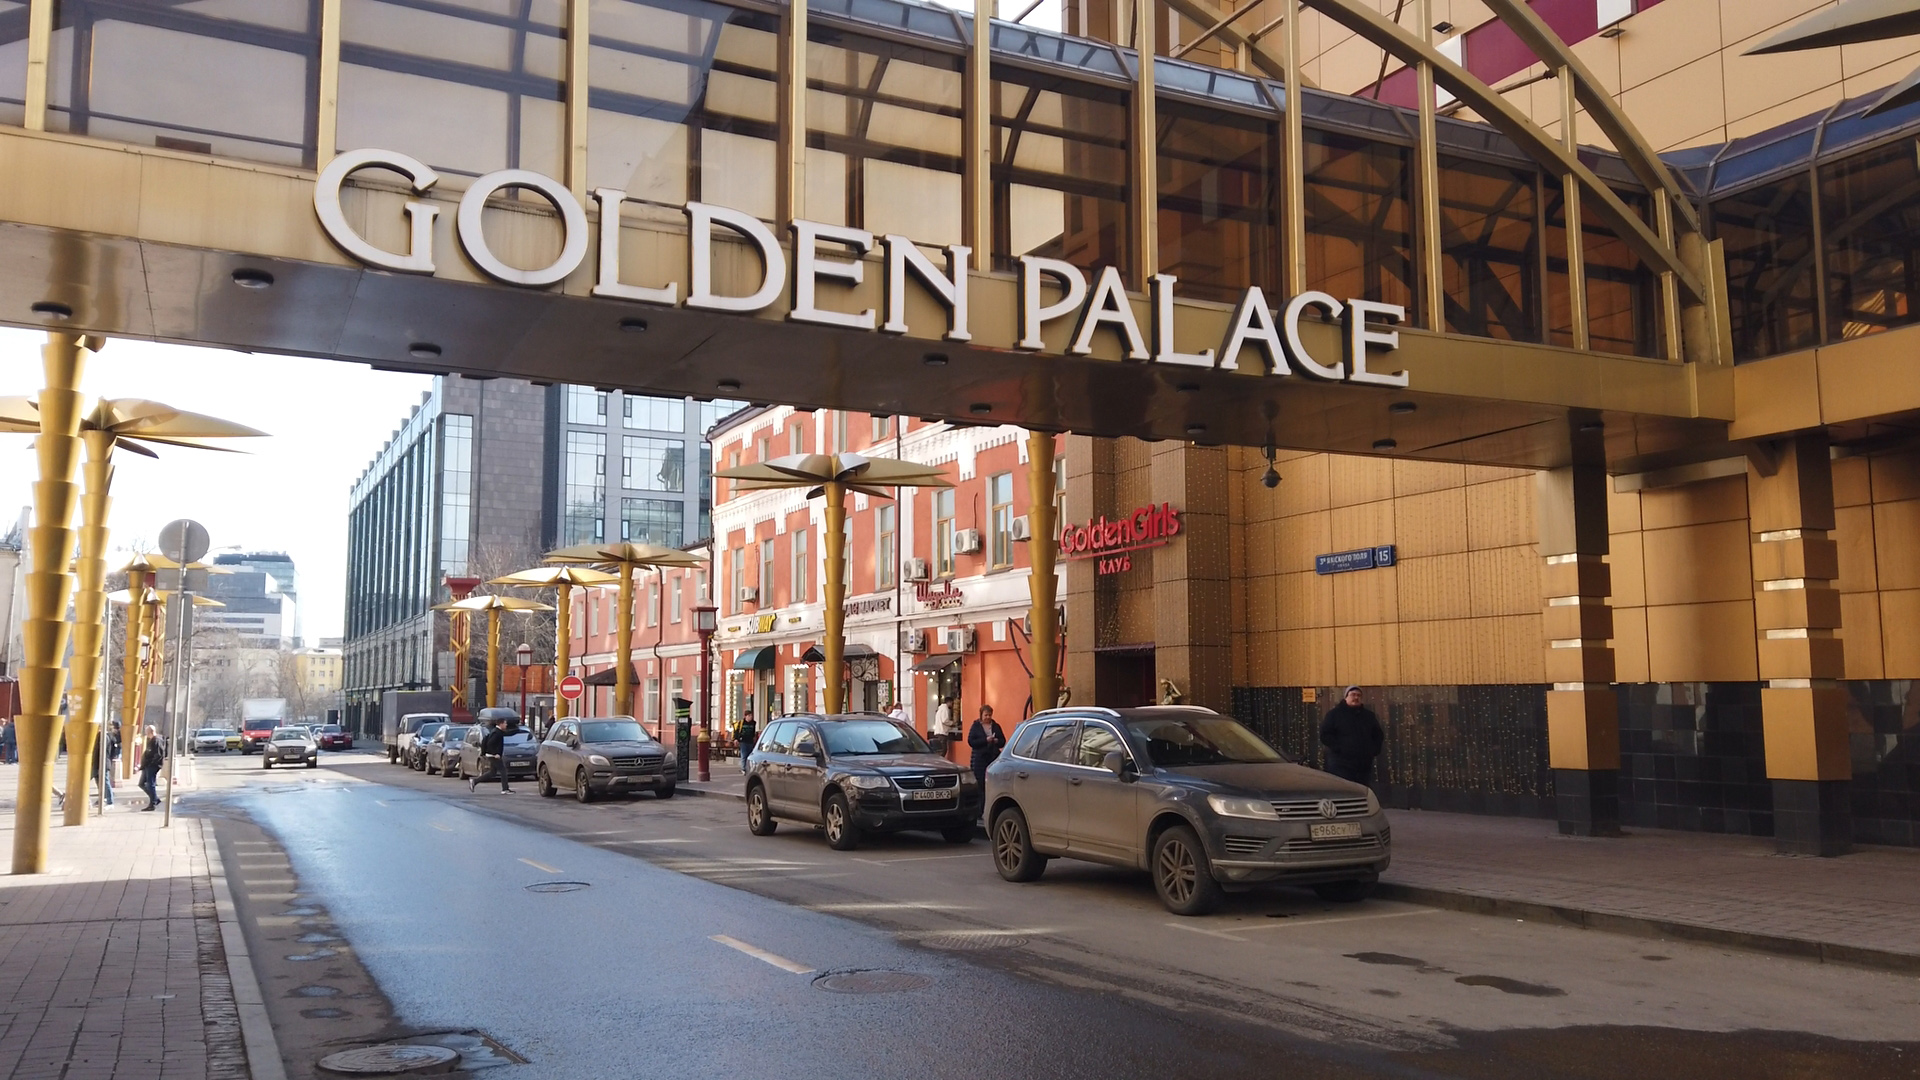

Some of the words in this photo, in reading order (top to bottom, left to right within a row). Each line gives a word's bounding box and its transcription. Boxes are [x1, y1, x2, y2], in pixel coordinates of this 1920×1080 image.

[314, 148, 972, 341] GOLDEN
[1017, 254, 1410, 388] PALACE
[1379, 550, 1388, 561] 15
[1099, 557, 1132, 575] КЛУБ
[747, 612, 777, 635] SUBWAY
